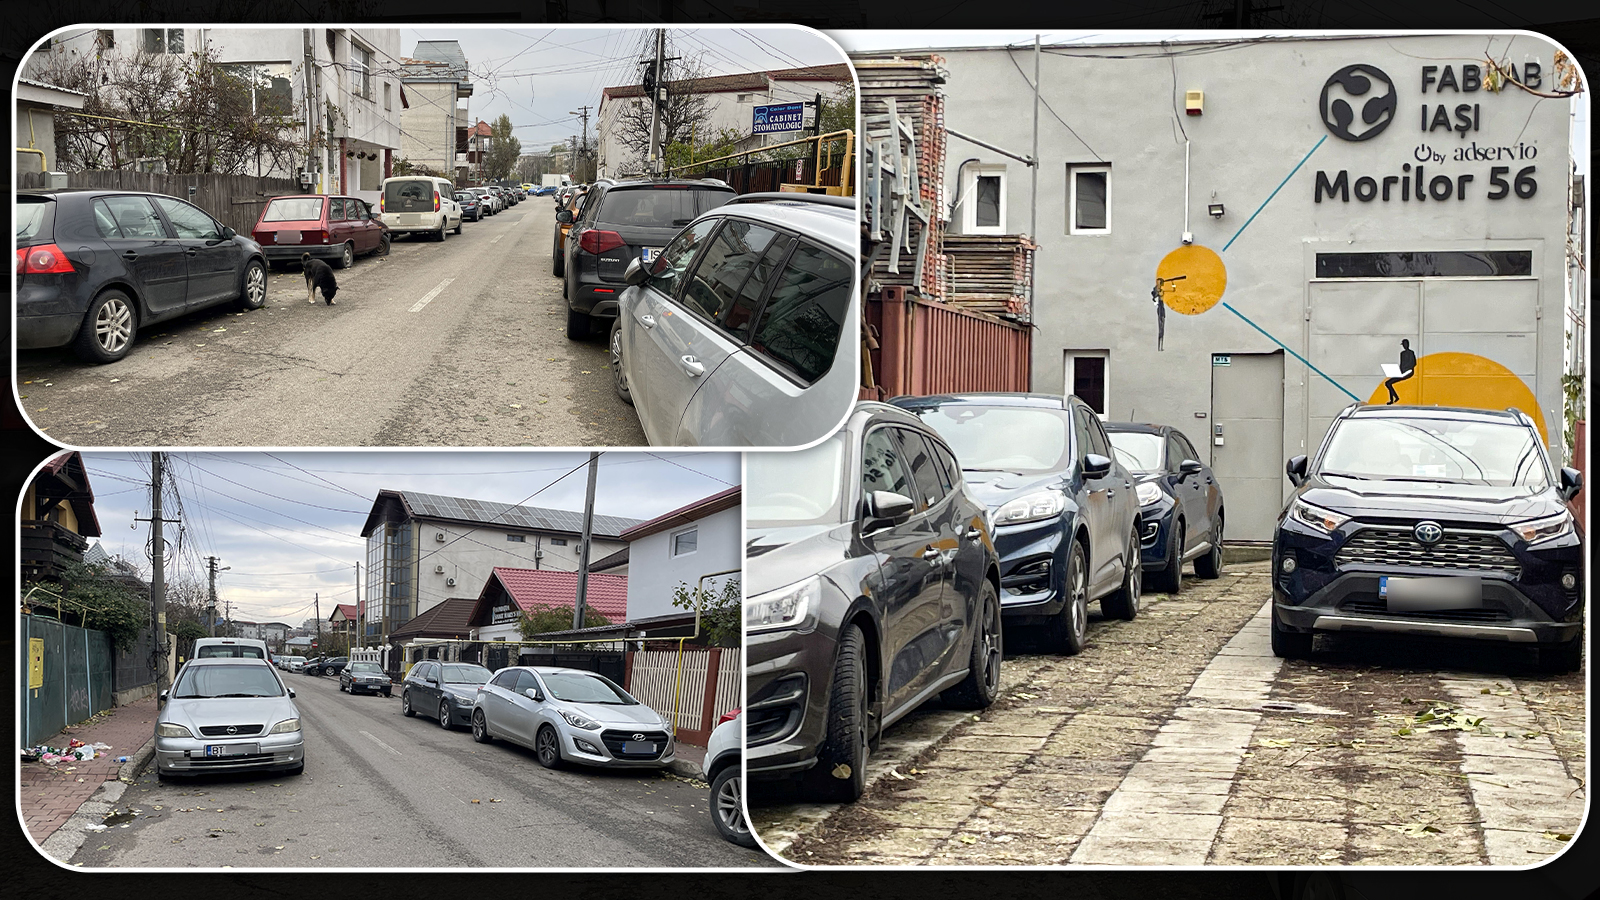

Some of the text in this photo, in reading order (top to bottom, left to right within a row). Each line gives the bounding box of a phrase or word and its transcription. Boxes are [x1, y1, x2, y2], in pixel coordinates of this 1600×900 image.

[770, 114, 802, 122] CABINET
[1421, 104, 1480, 138] IAȘI
[754, 122, 802, 132] STOMATOLOGIC
[1433, 141, 1538, 165] by adservio
[1314, 163, 1538, 203] Morilor 56
[212, 746, 223, 755] BT
